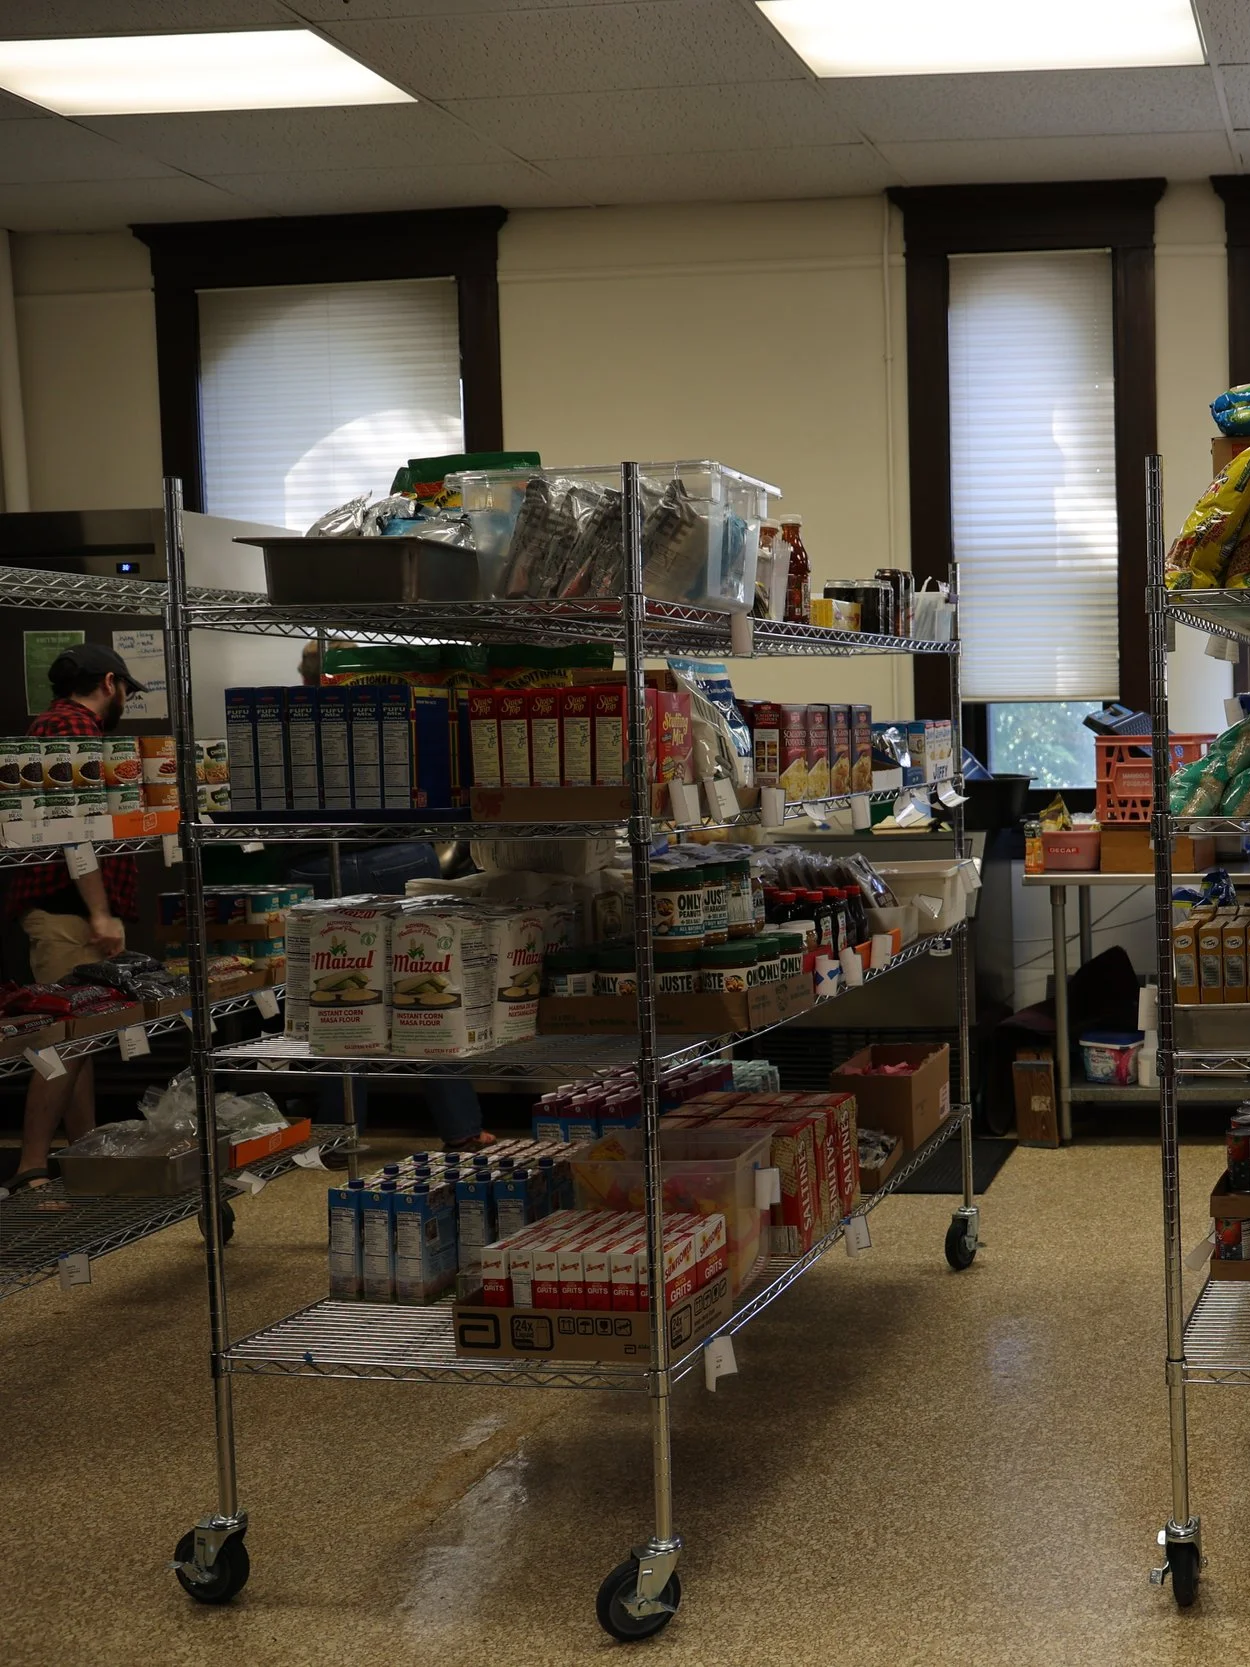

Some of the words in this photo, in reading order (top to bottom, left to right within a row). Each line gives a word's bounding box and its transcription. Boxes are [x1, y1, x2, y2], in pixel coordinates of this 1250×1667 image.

[471, 697, 492, 711] Stove
[502, 697, 523, 711] Stove
[533, 696, 554, 710] Stove
[564, 694, 586, 710] Stove
[597, 694, 619, 708] Stove
[604, 702, 617, 714] Top
[479, 705, 492, 716] Top
[510, 705, 522, 716] Top
[540, 704, 553, 716] Top
[572, 703, 585, 715] Top
[663, 712, 688, 731] Stuffing
[672, 730, 684, 746] Mix
[314, 950, 374, 970] Maizal
[394, 954, 450, 973] Maizal
[759, 964, 779, 980] ONLY
[660, 975, 692, 991] JUSTE
[840, 1110, 853, 1195] SALTINES
[826, 1134, 840, 1220] SALTINES
[799, 1141, 812, 1232] SALTINES
[664, 1240, 692, 1280] SUNFLOWER
[704, 1258, 723, 1279] GRITS
[484, 1284, 504, 1292] GRITS
[536, 1286, 558, 1294] GRITS
[562, 1286, 583, 1294] GRITS
[587, 1287, 608, 1296] GRITS
[614, 1288, 634, 1297] GRITS
[670, 1280, 692, 1302] GRITS
[515, 1320, 533, 1332] 24x
